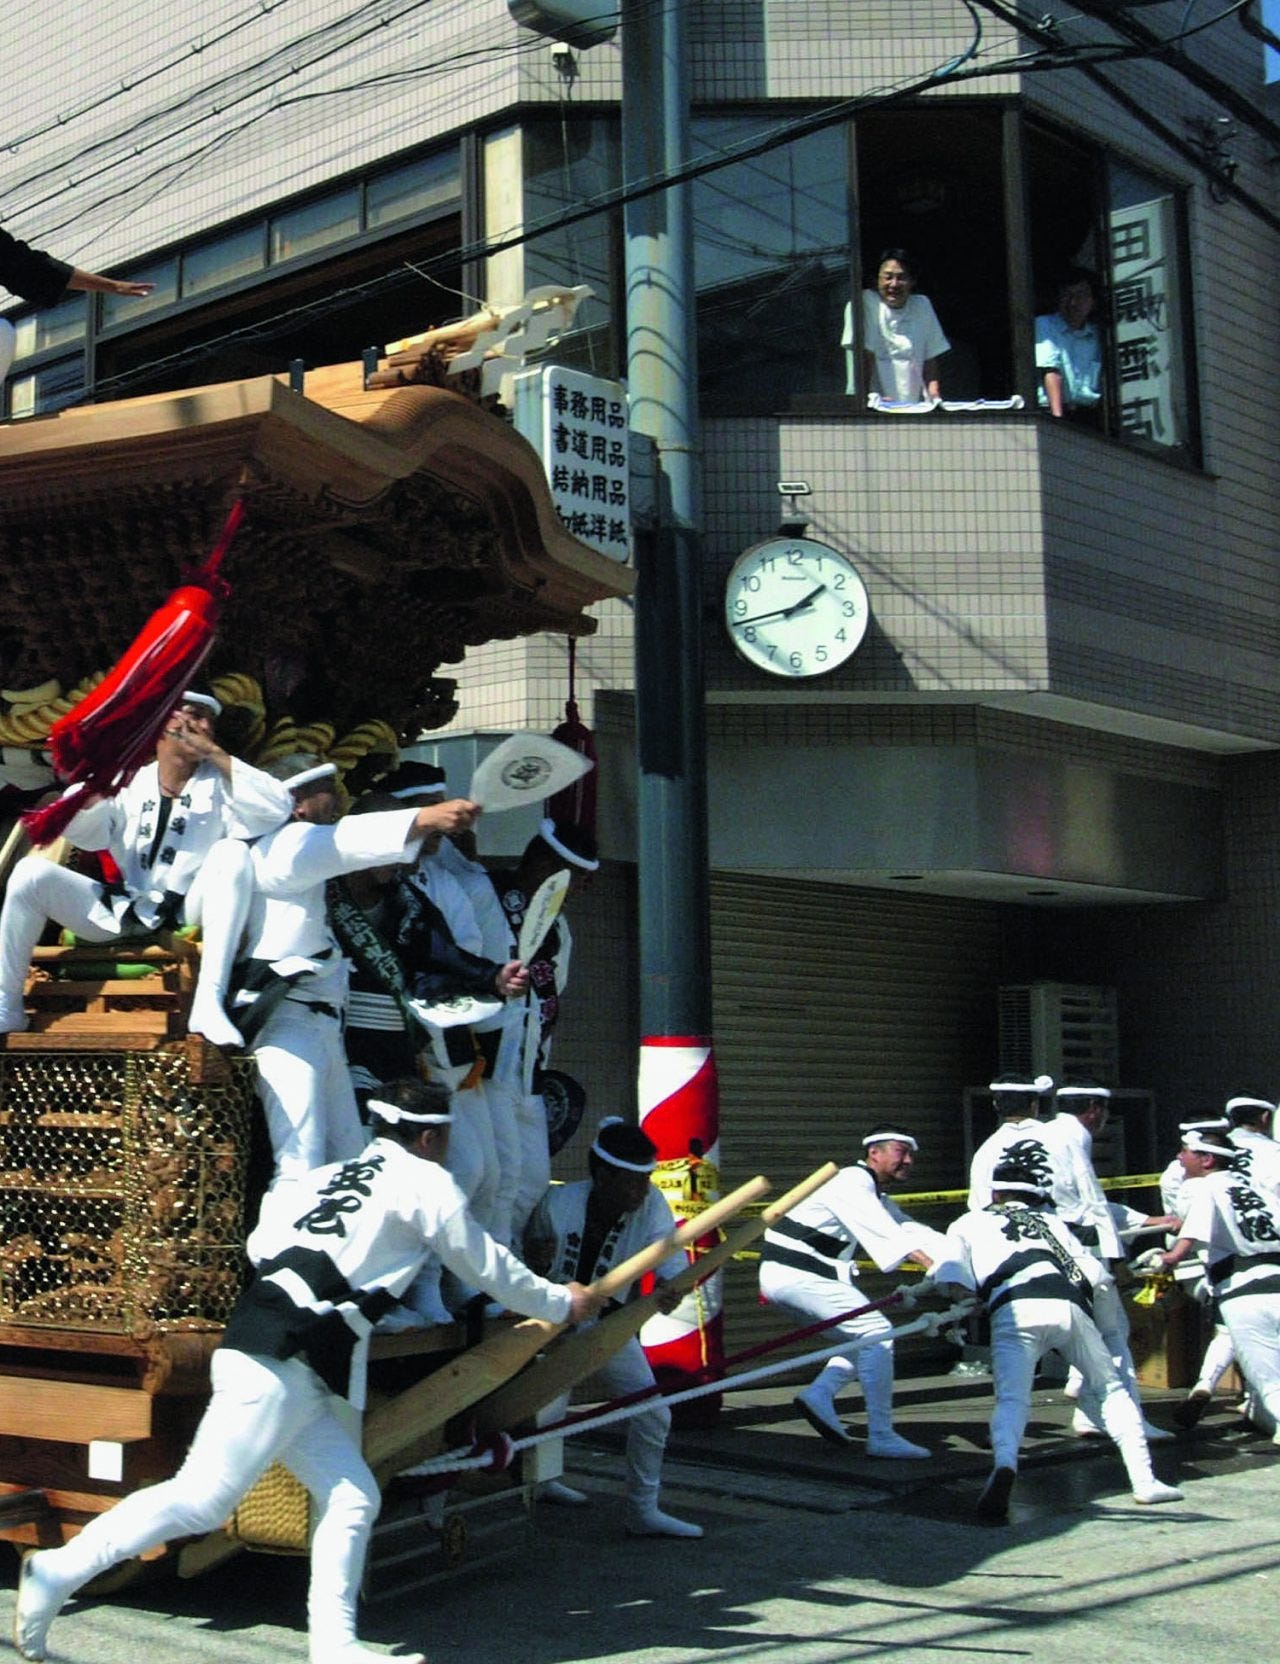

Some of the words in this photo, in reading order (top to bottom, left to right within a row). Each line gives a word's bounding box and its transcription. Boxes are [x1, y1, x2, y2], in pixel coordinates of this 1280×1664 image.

[553, 384, 626, 429] 事務用品
[553, 421, 626, 468] 書道用品
[552, 464, 626, 507] 結納用品
[760, 557, 775, 572] 11
[785, 549, 804, 565] 12
[816, 558, 822, 571] 1
[741, 575, 761, 592] 10
[834, 574, 845, 590] 2
[734, 600, 748, 616] 9
[842, 601, 855, 617] 3
[744, 626, 757, 643] 8
[835, 629, 847, 642] 4
[768, 645, 778, 660] 7
[790, 651, 802, 668] 6
[815, 646, 827, 661] 5
